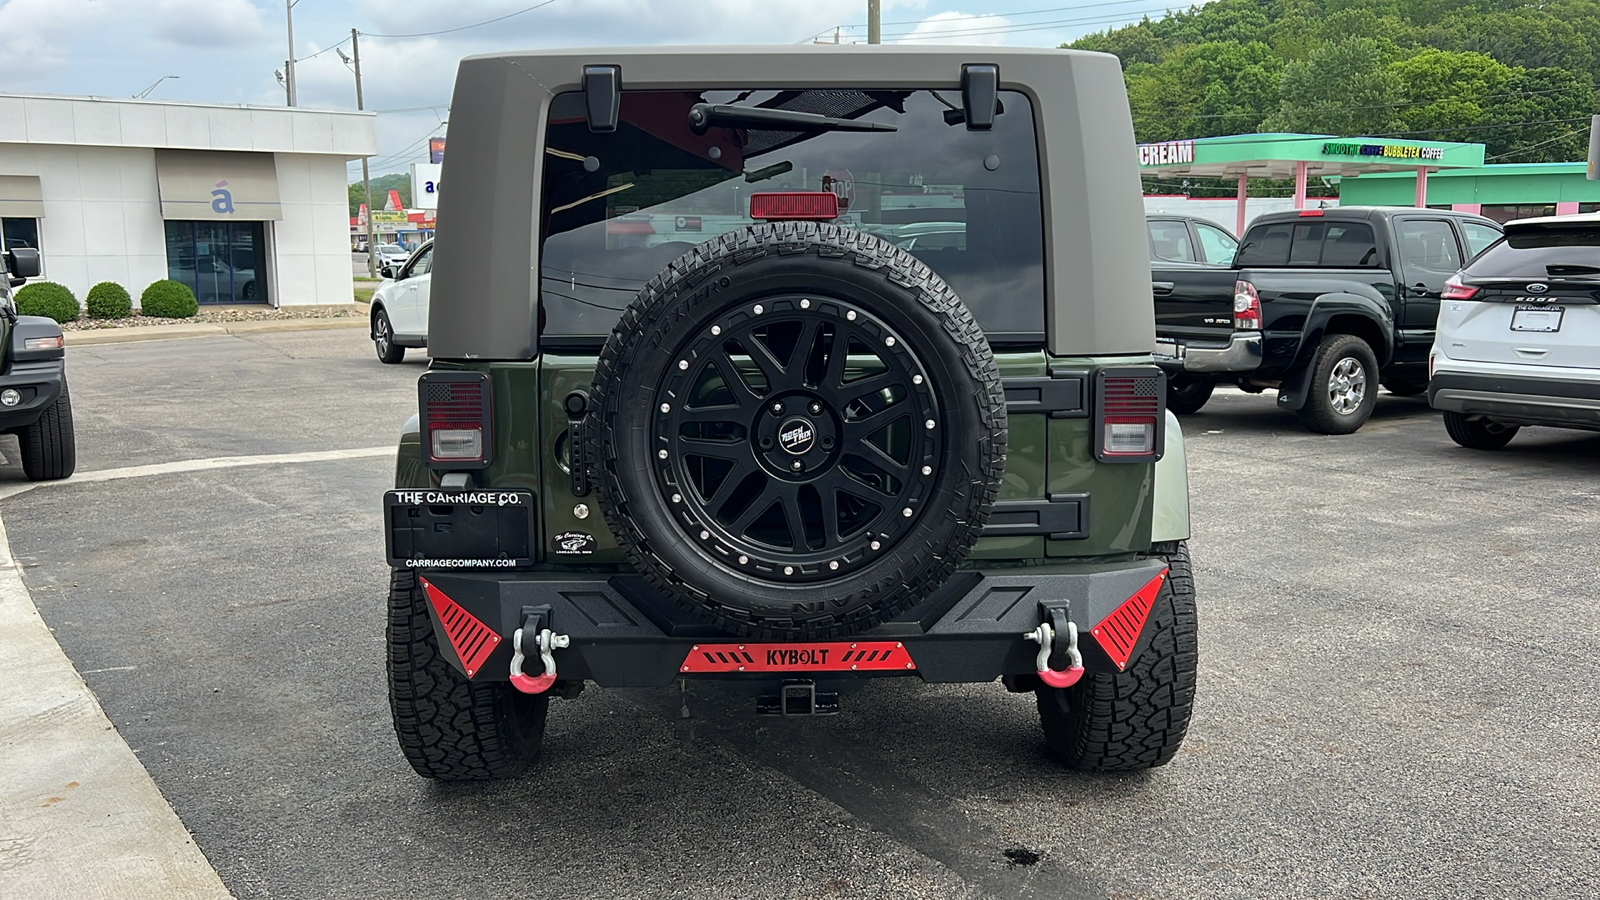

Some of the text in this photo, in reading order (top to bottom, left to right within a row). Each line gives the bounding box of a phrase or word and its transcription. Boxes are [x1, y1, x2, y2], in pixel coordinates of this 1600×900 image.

[1140, 143, 1193, 165] CREAM
[1420, 147, 1444, 160] COFFEE
[823, 180, 853, 199] STOP
[395, 491, 522, 506] THE CARRIAGE CO.
[405, 559, 516, 568] CARRIAGECOMPANY.COM
[766, 649, 830, 665] KYBOLT
